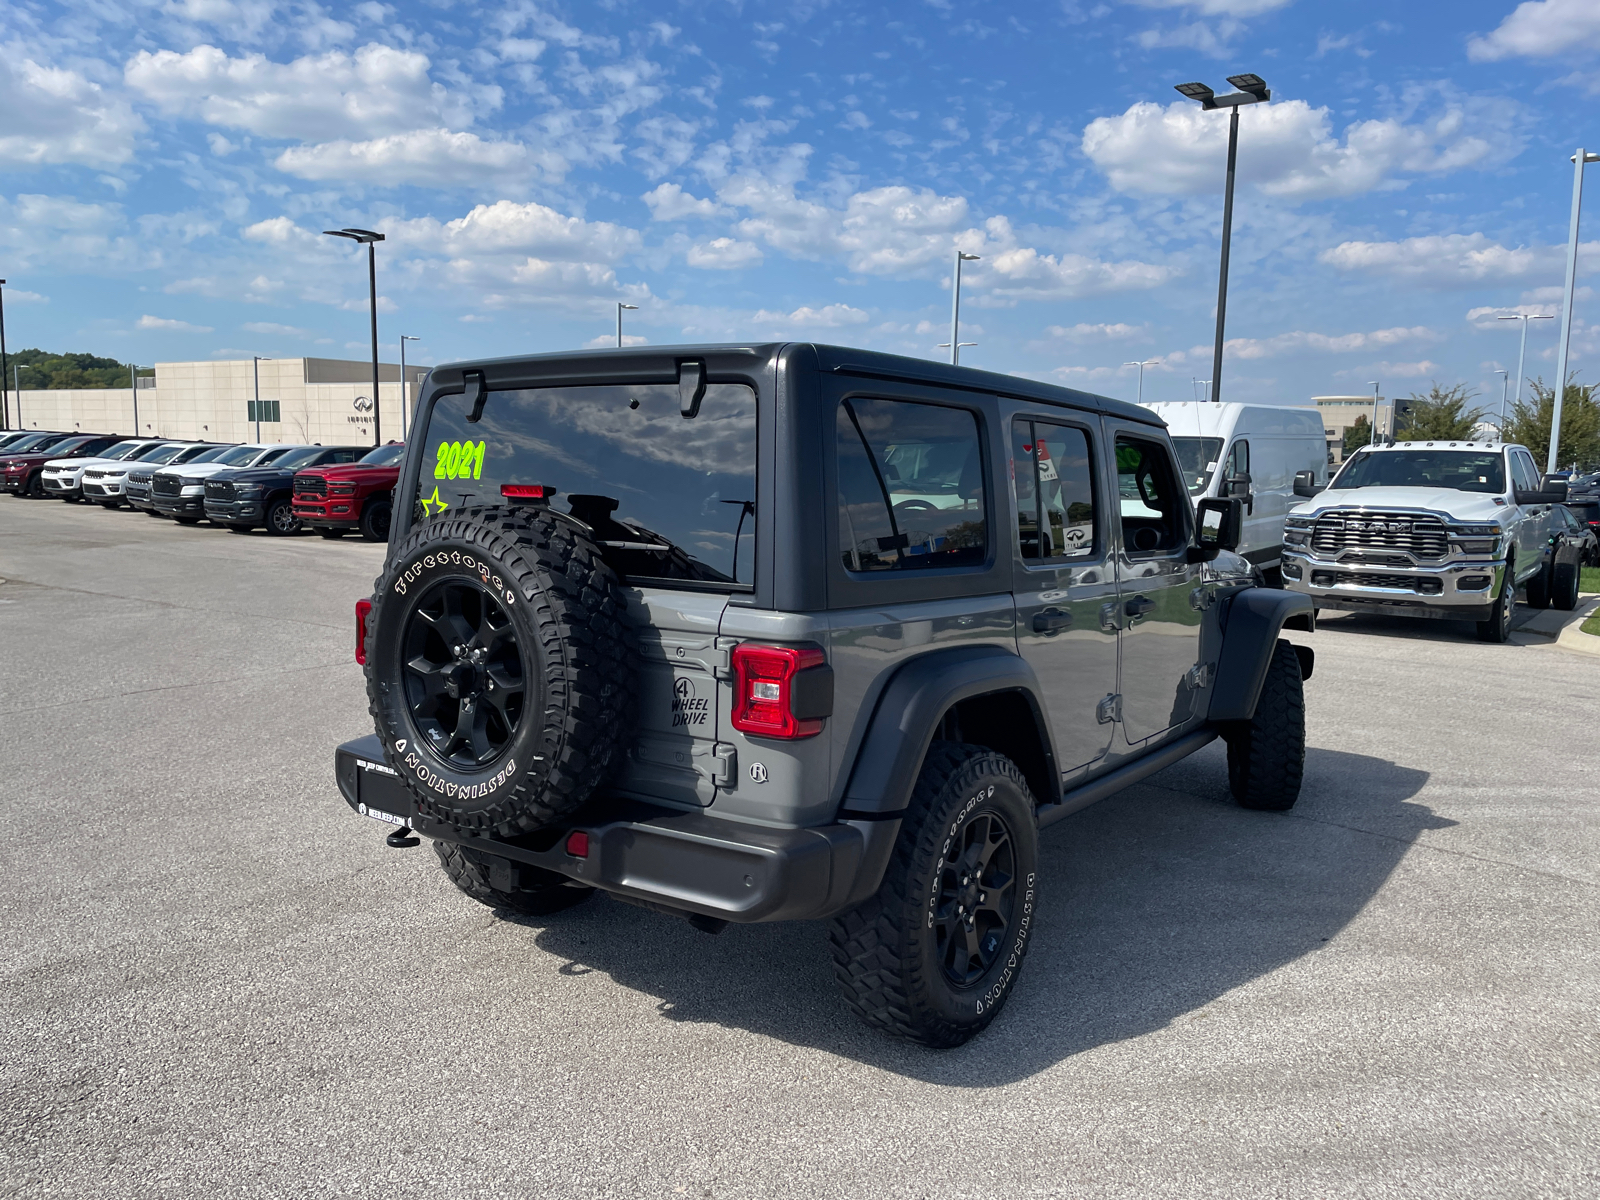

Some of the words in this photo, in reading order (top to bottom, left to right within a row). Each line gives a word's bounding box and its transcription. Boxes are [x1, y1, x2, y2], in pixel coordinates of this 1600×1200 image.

[434, 440, 486, 480] 2021
[1345, 520, 1411, 533] RAM
[394, 550, 504, 595] Firestone
[671, 698, 708, 712] WHEEL
[672, 711, 708, 727] DRIVE
[404, 752, 517, 799] DESTINATION
[985, 872, 1035, 1009] DESTINATION
